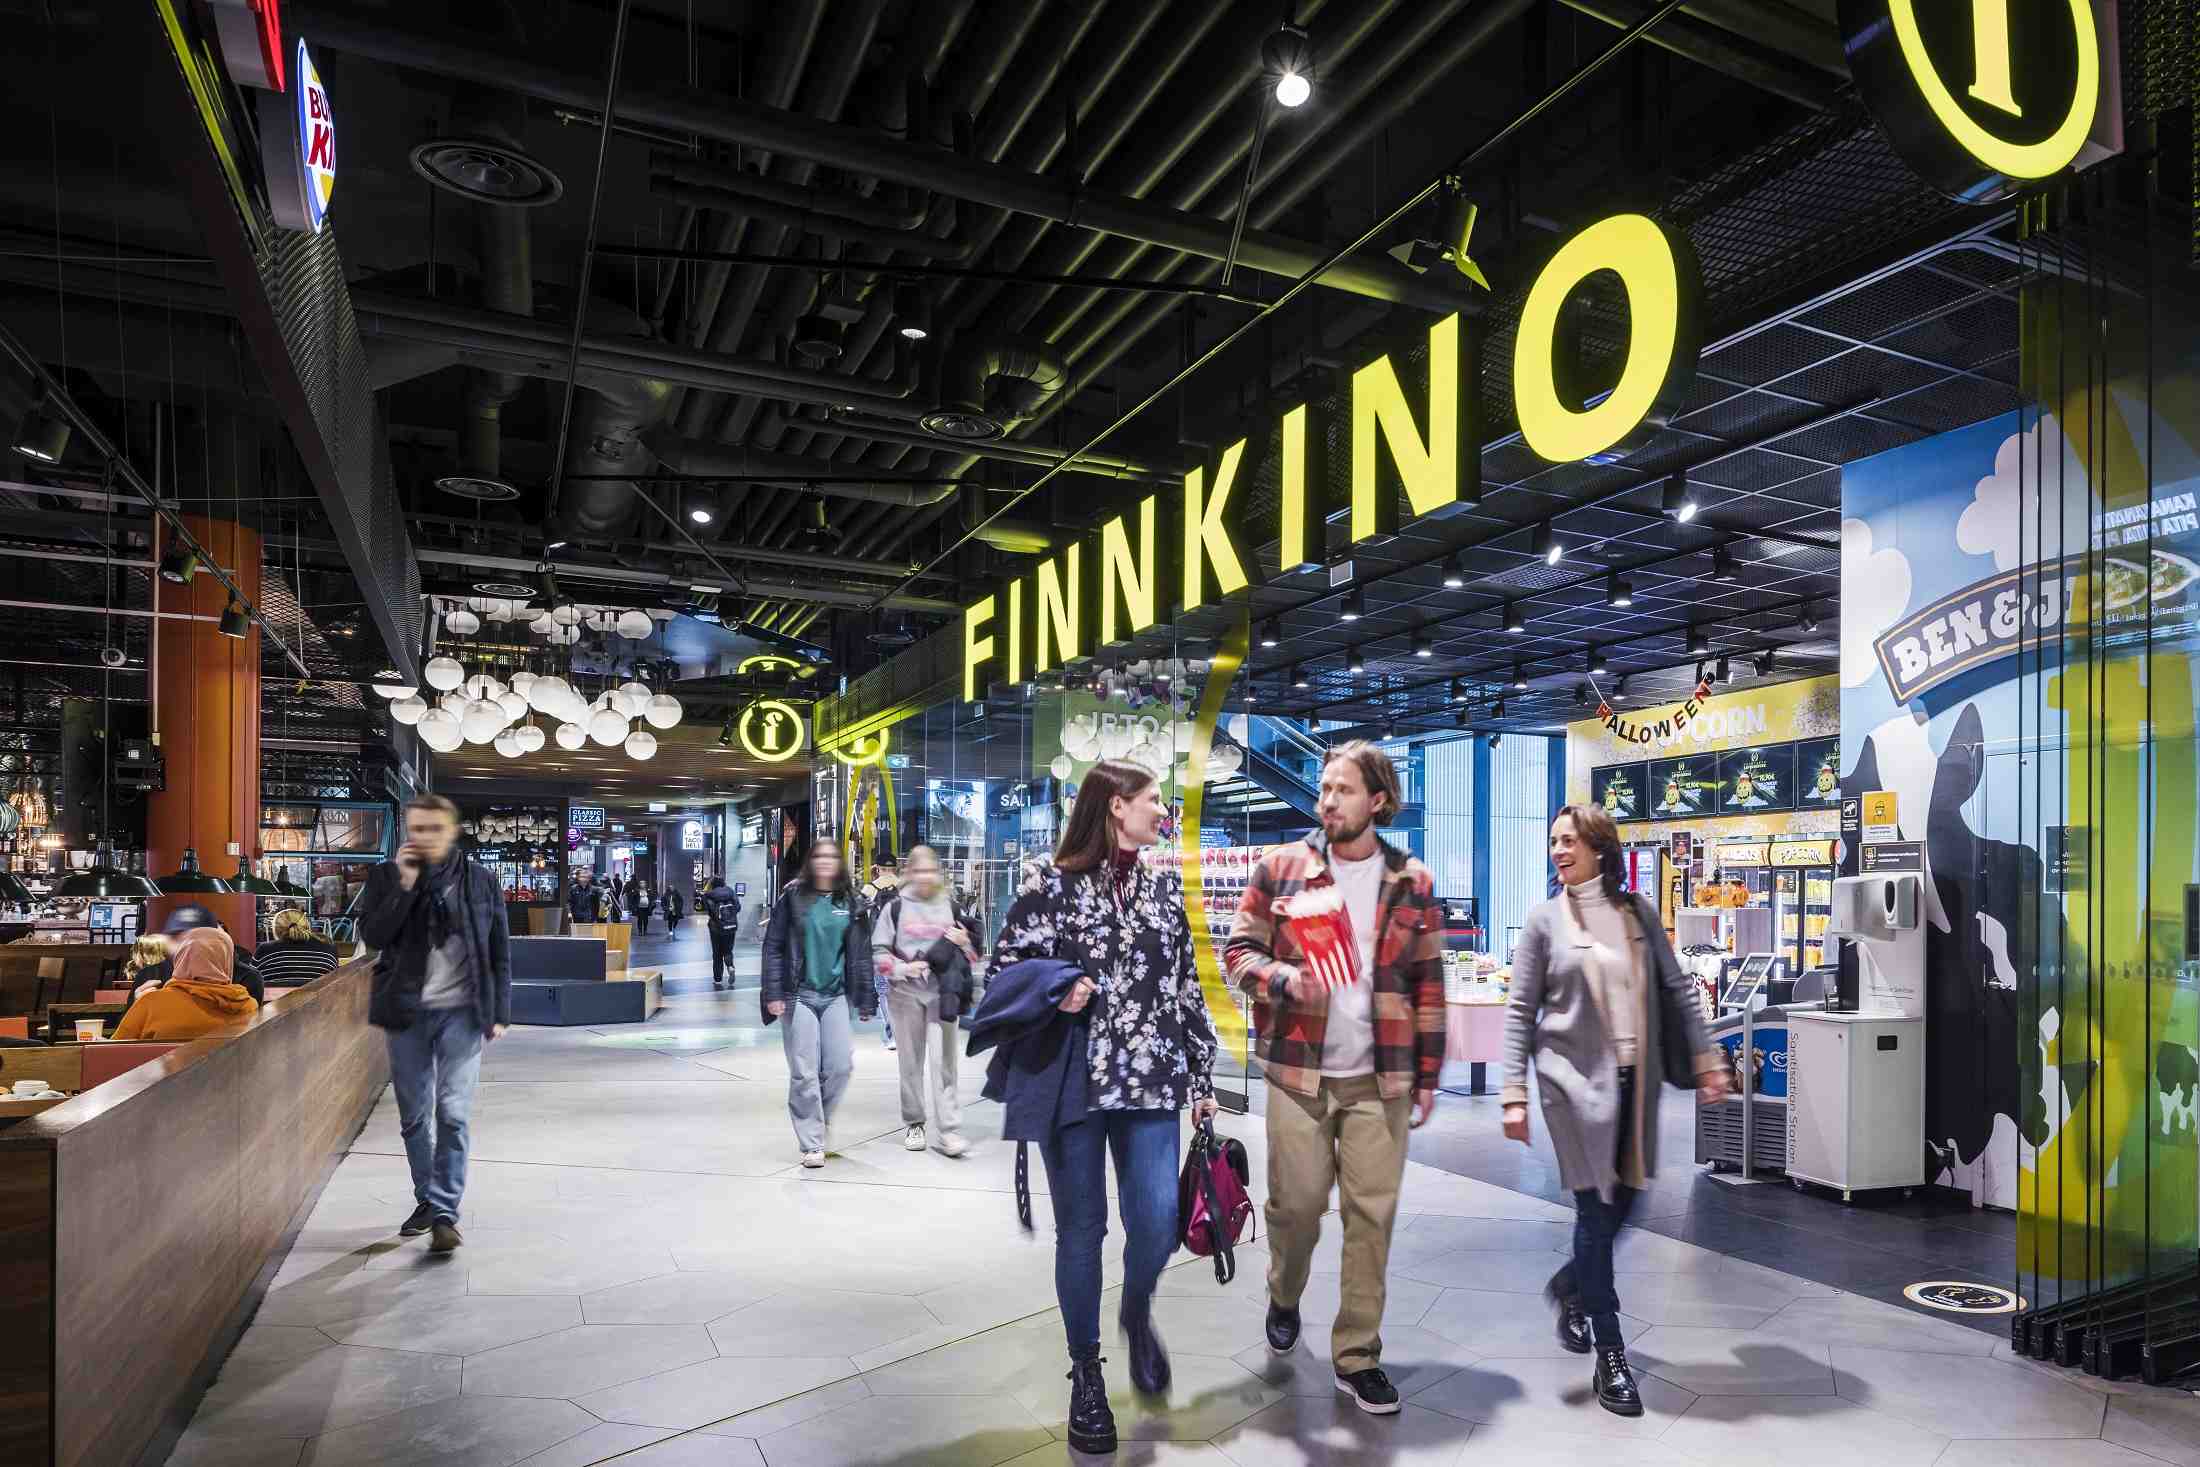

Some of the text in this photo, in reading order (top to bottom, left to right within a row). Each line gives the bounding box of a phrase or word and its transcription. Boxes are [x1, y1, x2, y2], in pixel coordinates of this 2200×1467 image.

[308, 86, 332, 122] BU
[308, 124, 336, 171] KI
[964, 212, 1679, 704] FINNKINO
[1892, 600, 1988, 684] BEN
[1990, 588, 2030, 639] &
[1788, 1115, 1799, 1164] Station
